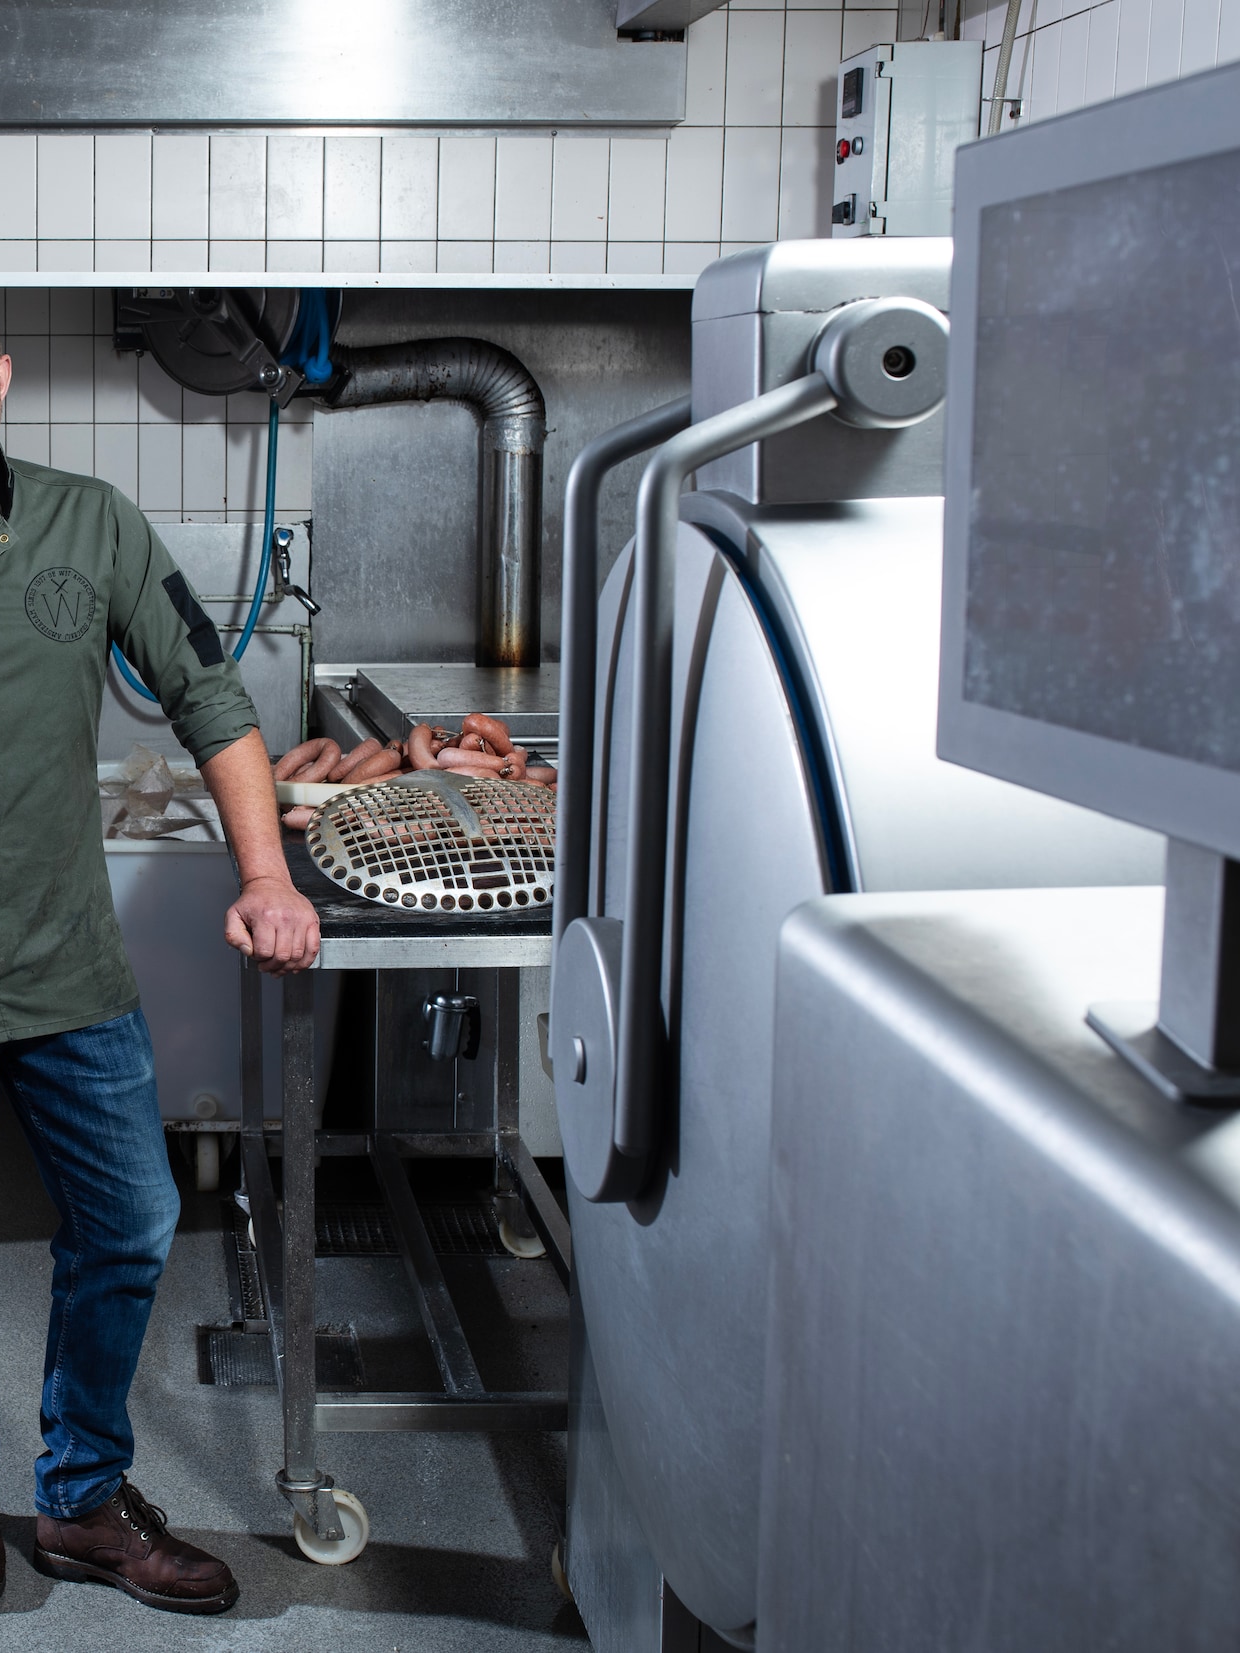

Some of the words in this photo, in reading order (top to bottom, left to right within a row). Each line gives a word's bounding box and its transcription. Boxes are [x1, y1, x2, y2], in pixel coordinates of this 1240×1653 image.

[47, 570, 56, 579] DE
[29, 609, 62, 640] AMSTERDAM
[40, 591, 82, 628] W
